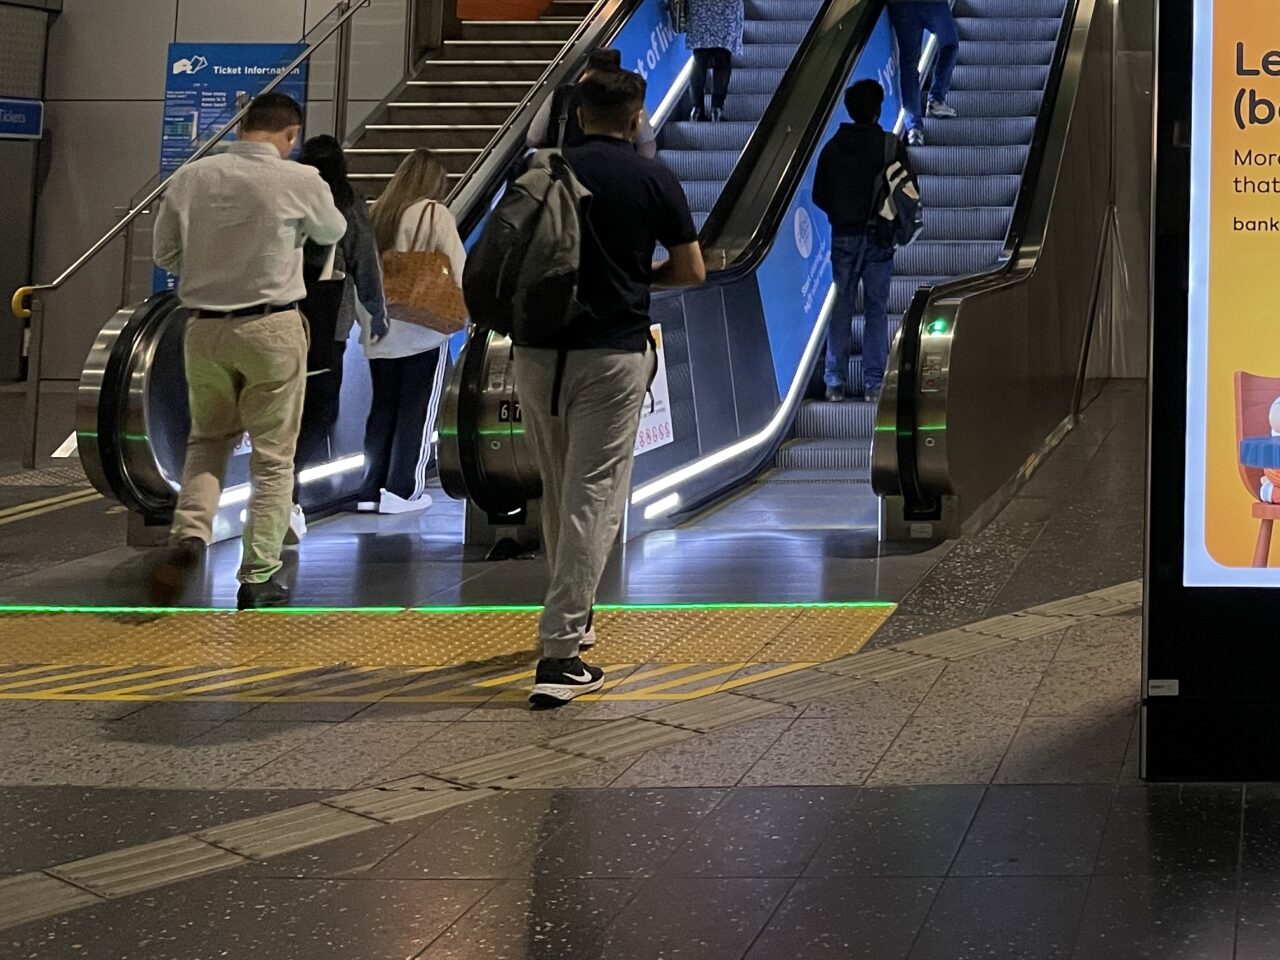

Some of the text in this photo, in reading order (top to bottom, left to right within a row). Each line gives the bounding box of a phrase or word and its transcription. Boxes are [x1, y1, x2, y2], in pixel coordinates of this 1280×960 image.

[213, 65, 241, 75] Ticket
[1233, 176, 1280, 194] that
[1233, 217, 1280, 232] bank
[501, 405, 521, 420] 6 7
